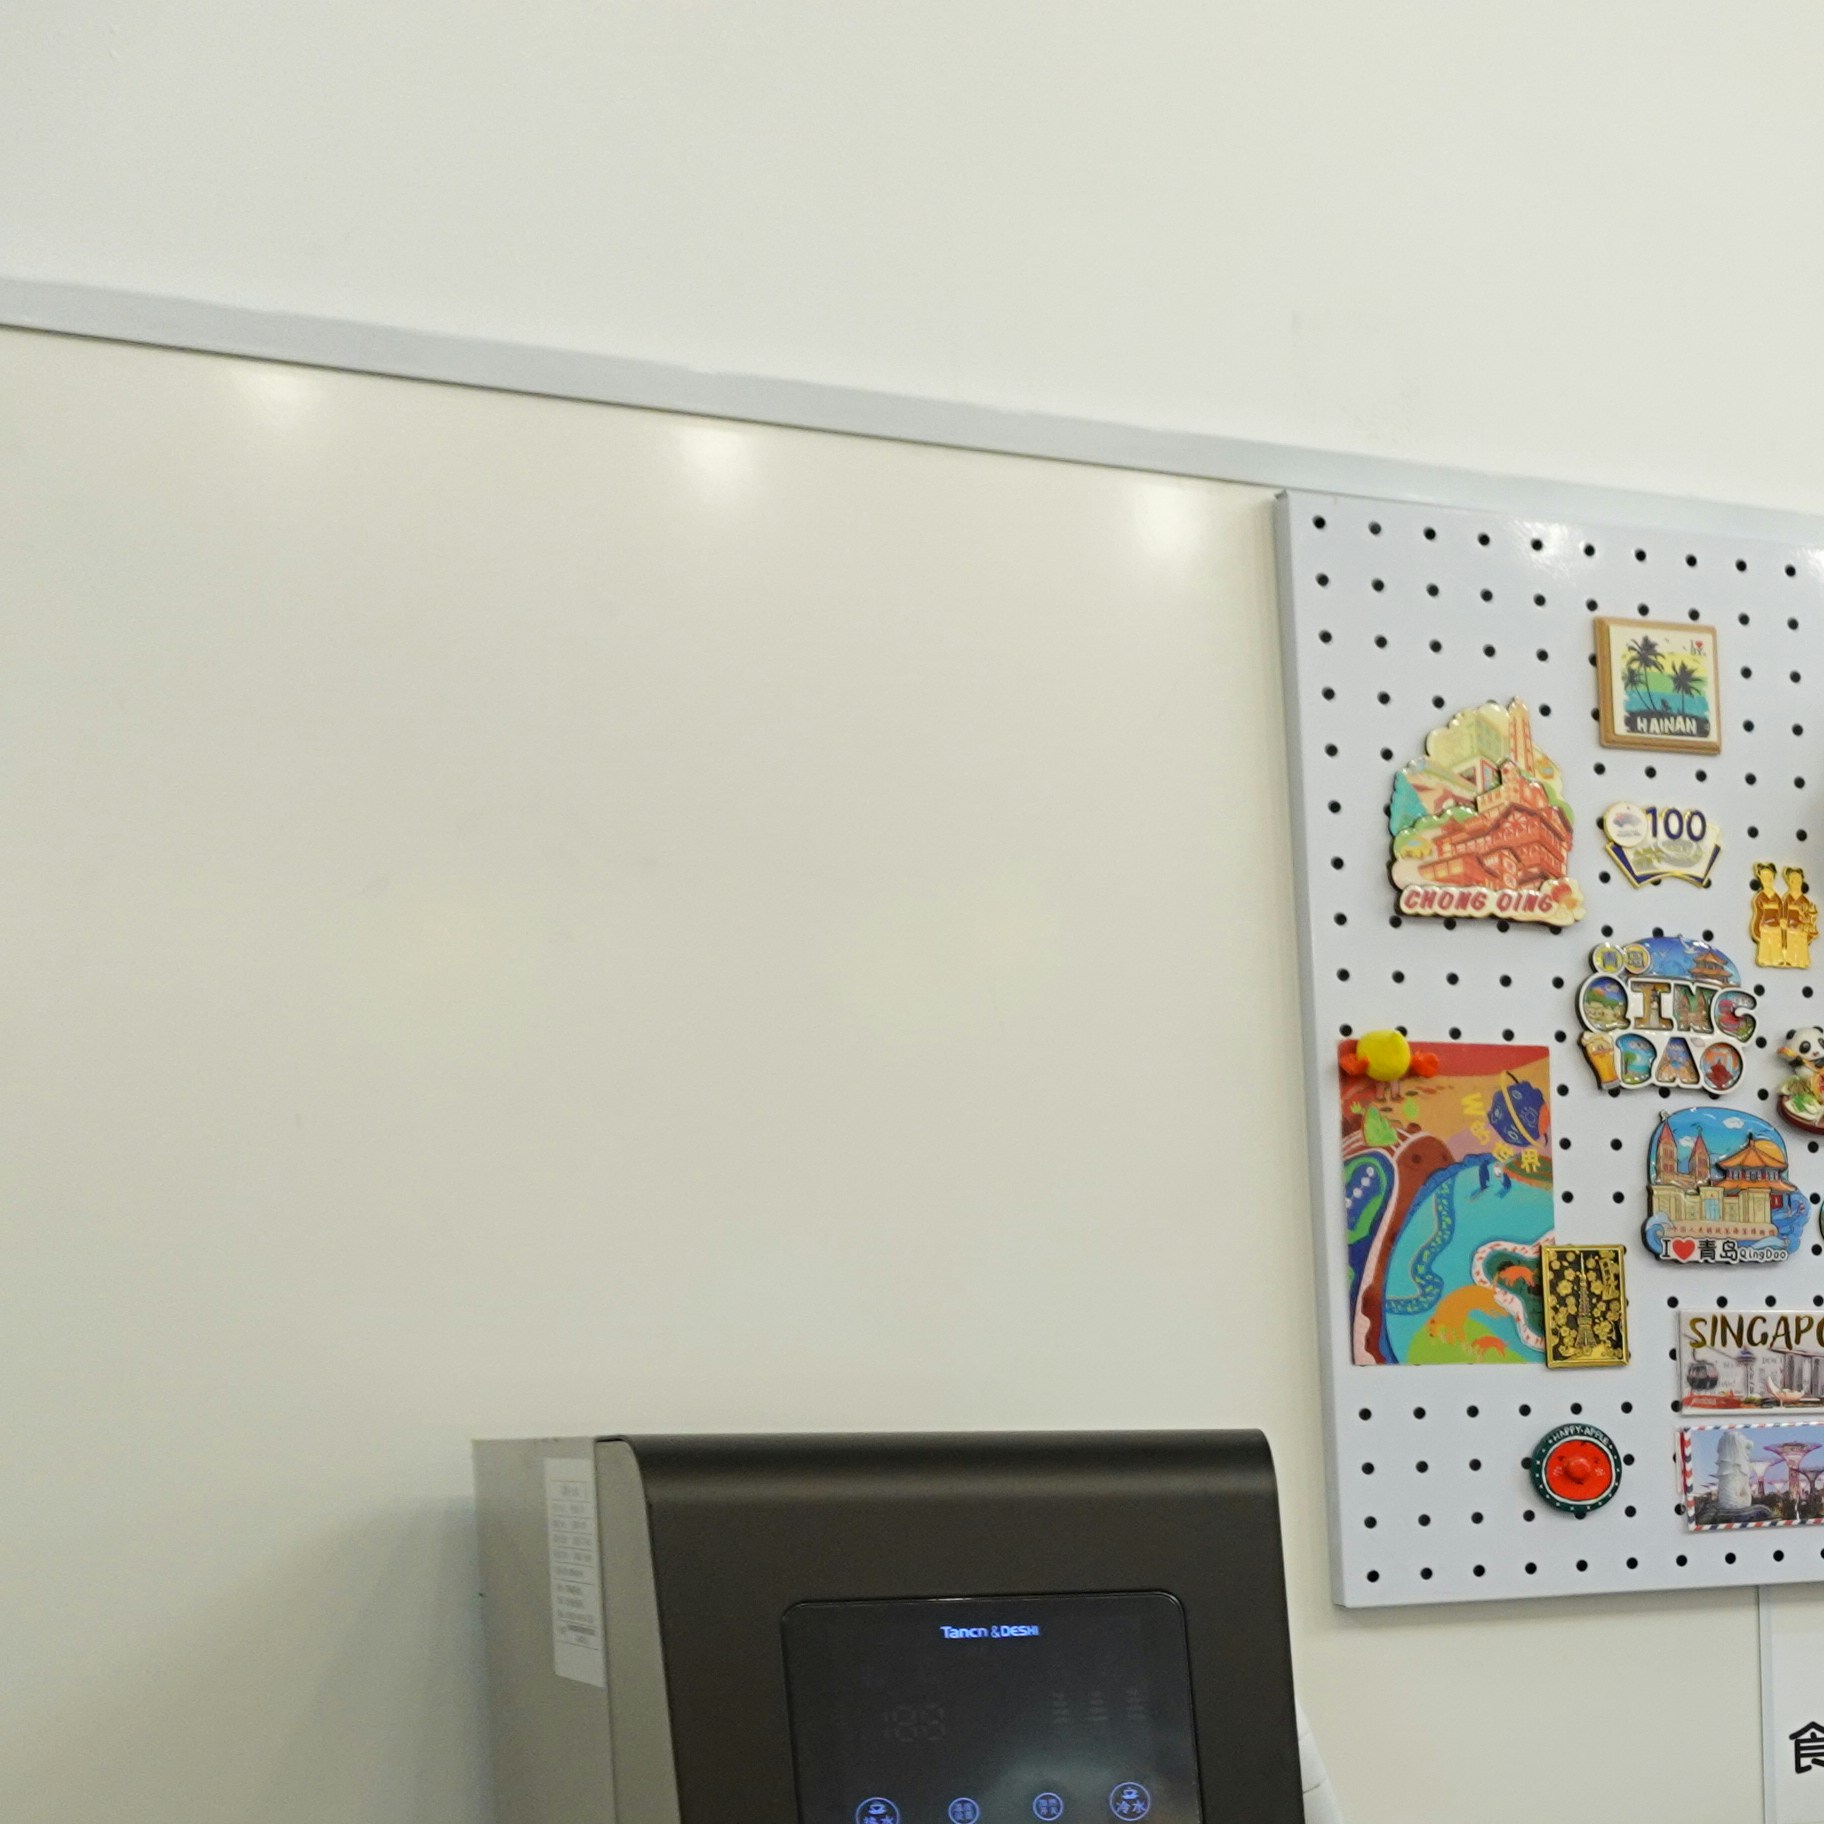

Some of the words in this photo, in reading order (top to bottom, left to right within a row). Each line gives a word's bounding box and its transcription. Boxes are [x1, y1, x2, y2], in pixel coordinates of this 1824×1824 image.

[1636, 716, 1697, 735] HAINAN
[1645, 807, 1707, 842] 100
[1404, 889, 1488, 912] CHONG
[1579, 974, 1758, 1044] QING
[1615, 1032, 1744, 1094] DAO
[1662, 1239, 1671, 1258] I
[1698, 1240, 1738, 1262] 青岛
